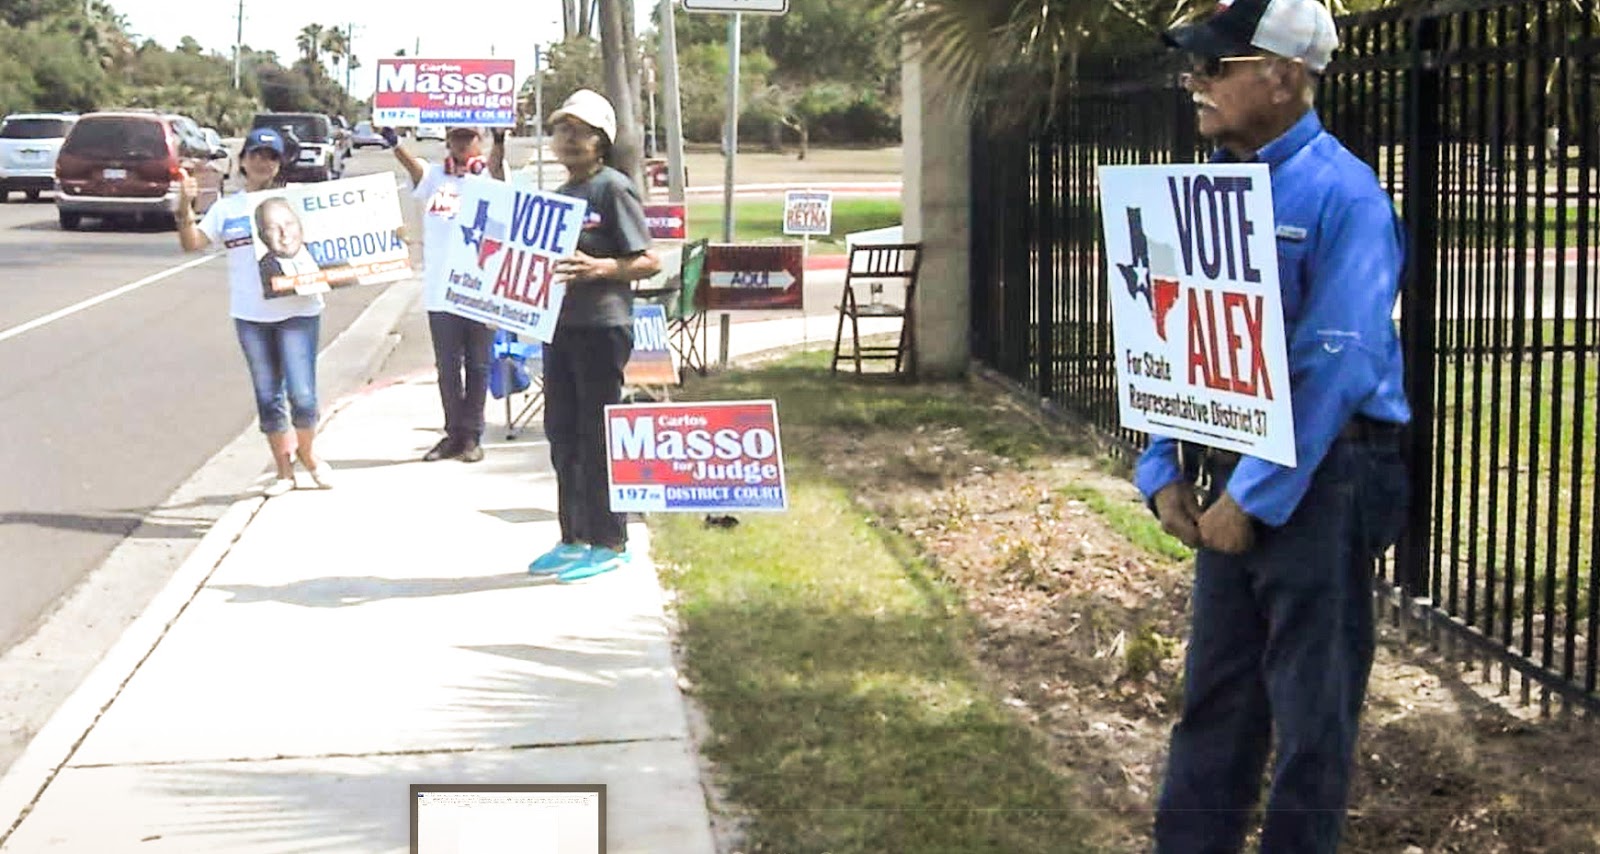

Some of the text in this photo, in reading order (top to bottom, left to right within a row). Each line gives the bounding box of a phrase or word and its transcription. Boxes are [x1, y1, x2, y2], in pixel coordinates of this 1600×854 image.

[379, 63, 513, 94] Masso
[444, 93, 512, 109] Judge
[303, 189, 366, 212] ELECT
[510, 190, 574, 253] VOTE
[1167, 174, 1262, 283] VOTE
[308, 230, 402, 264] CORDOVA
[463, 272, 482, 291] State
[493, 248, 558, 310] ALEX
[1188, 286, 1273, 401] ALEX
[1126, 349, 1171, 381] For State
[658, 415, 708, 426] Carlos
[1129, 383, 1209, 424] Representative
[1210, 401, 1253, 433] District
[1254, 408, 1267, 438] 37
[611, 416, 774, 460] Masso
[692, 460, 777, 483] Judge
[667, 486, 728, 500] DISTRICT
[733, 485, 781, 500] COURT
